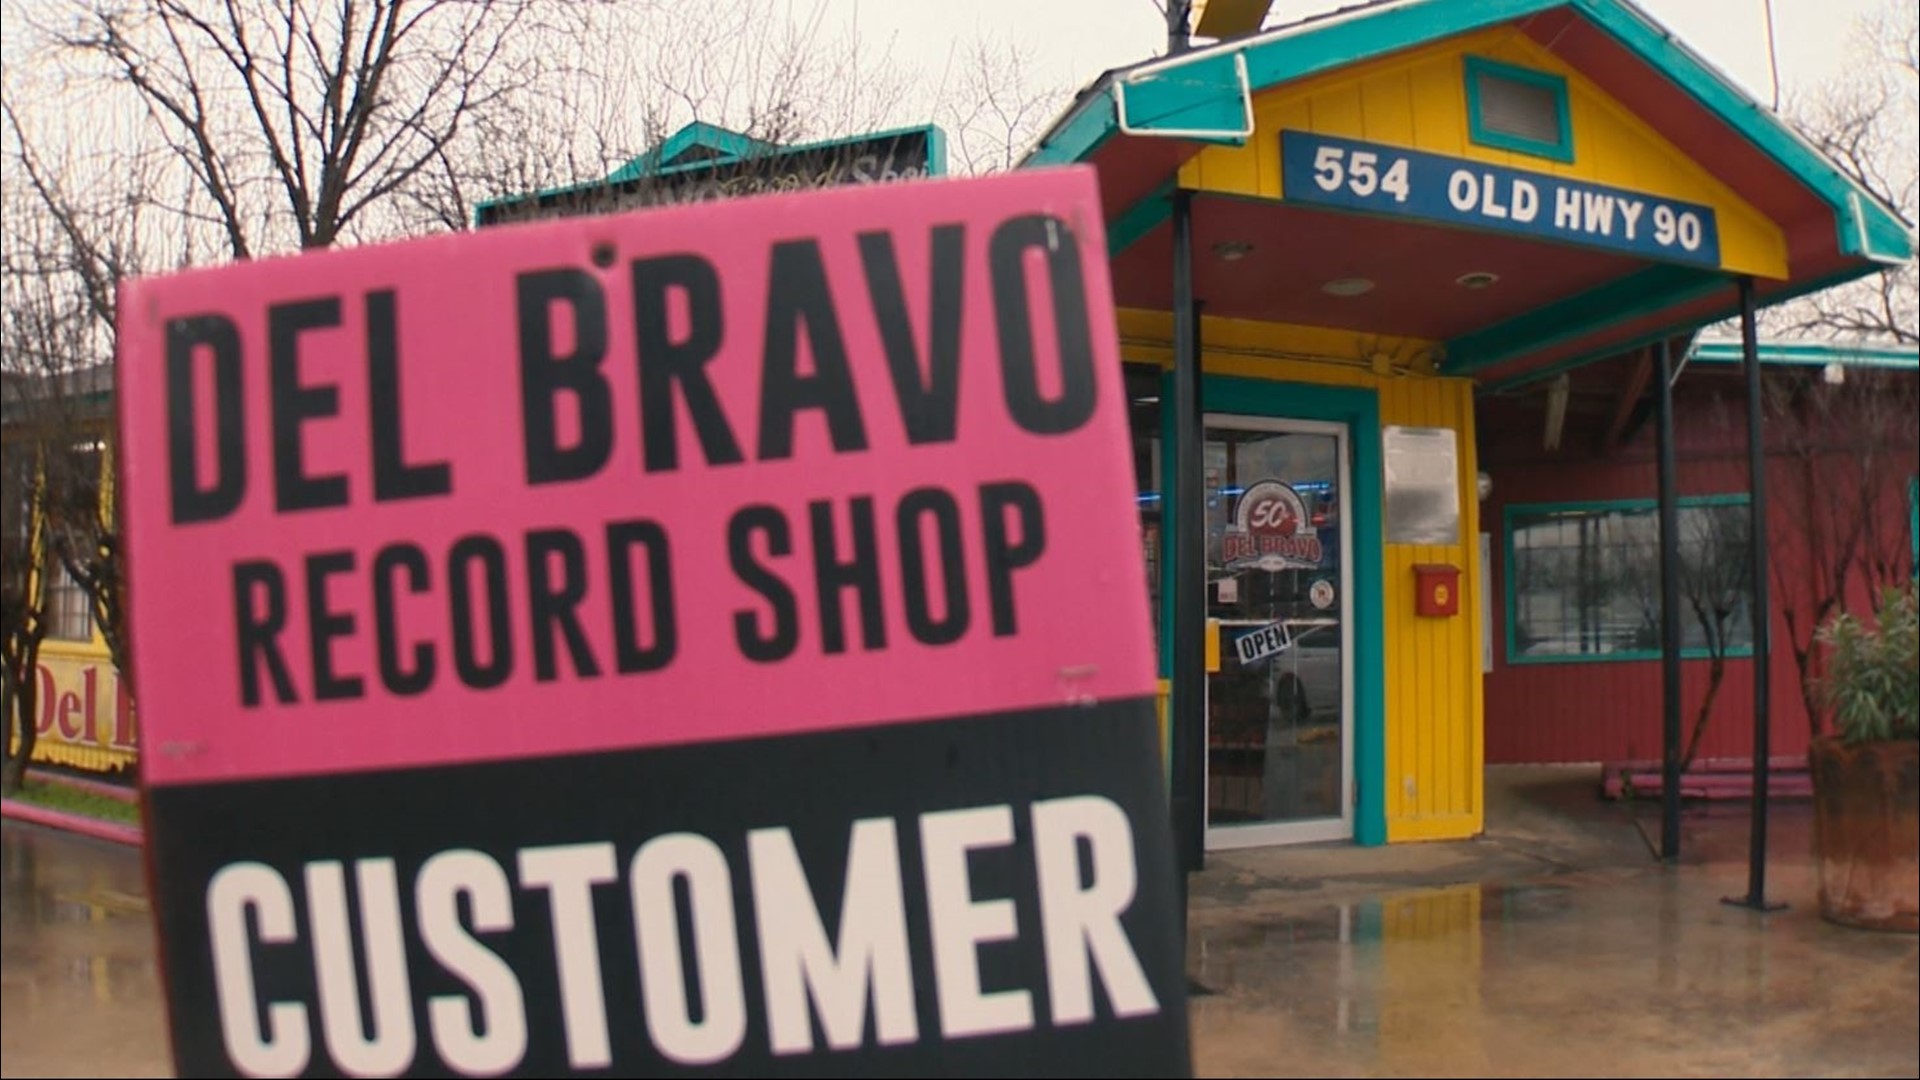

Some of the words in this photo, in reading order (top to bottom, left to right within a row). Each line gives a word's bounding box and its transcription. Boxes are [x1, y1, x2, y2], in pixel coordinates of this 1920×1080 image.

[1313, 145, 1410, 202] 554
[1448, 170, 1539, 223] OLD
[1553, 186, 1643, 241] HWY
[1652, 205, 1701, 252] 90
[162, 287, 454, 527] DEL
[515, 212, 1099, 486] BRAVO
[231, 519, 679, 709] RECORD
[727, 479, 1047, 665] SHOP
[1223, 533, 1257, 561] DEL
[1259, 536, 1322, 562] BRAVO
[1241, 623, 1288, 660] OPEN
[206, 795, 1159, 1079] CUSTOMER
